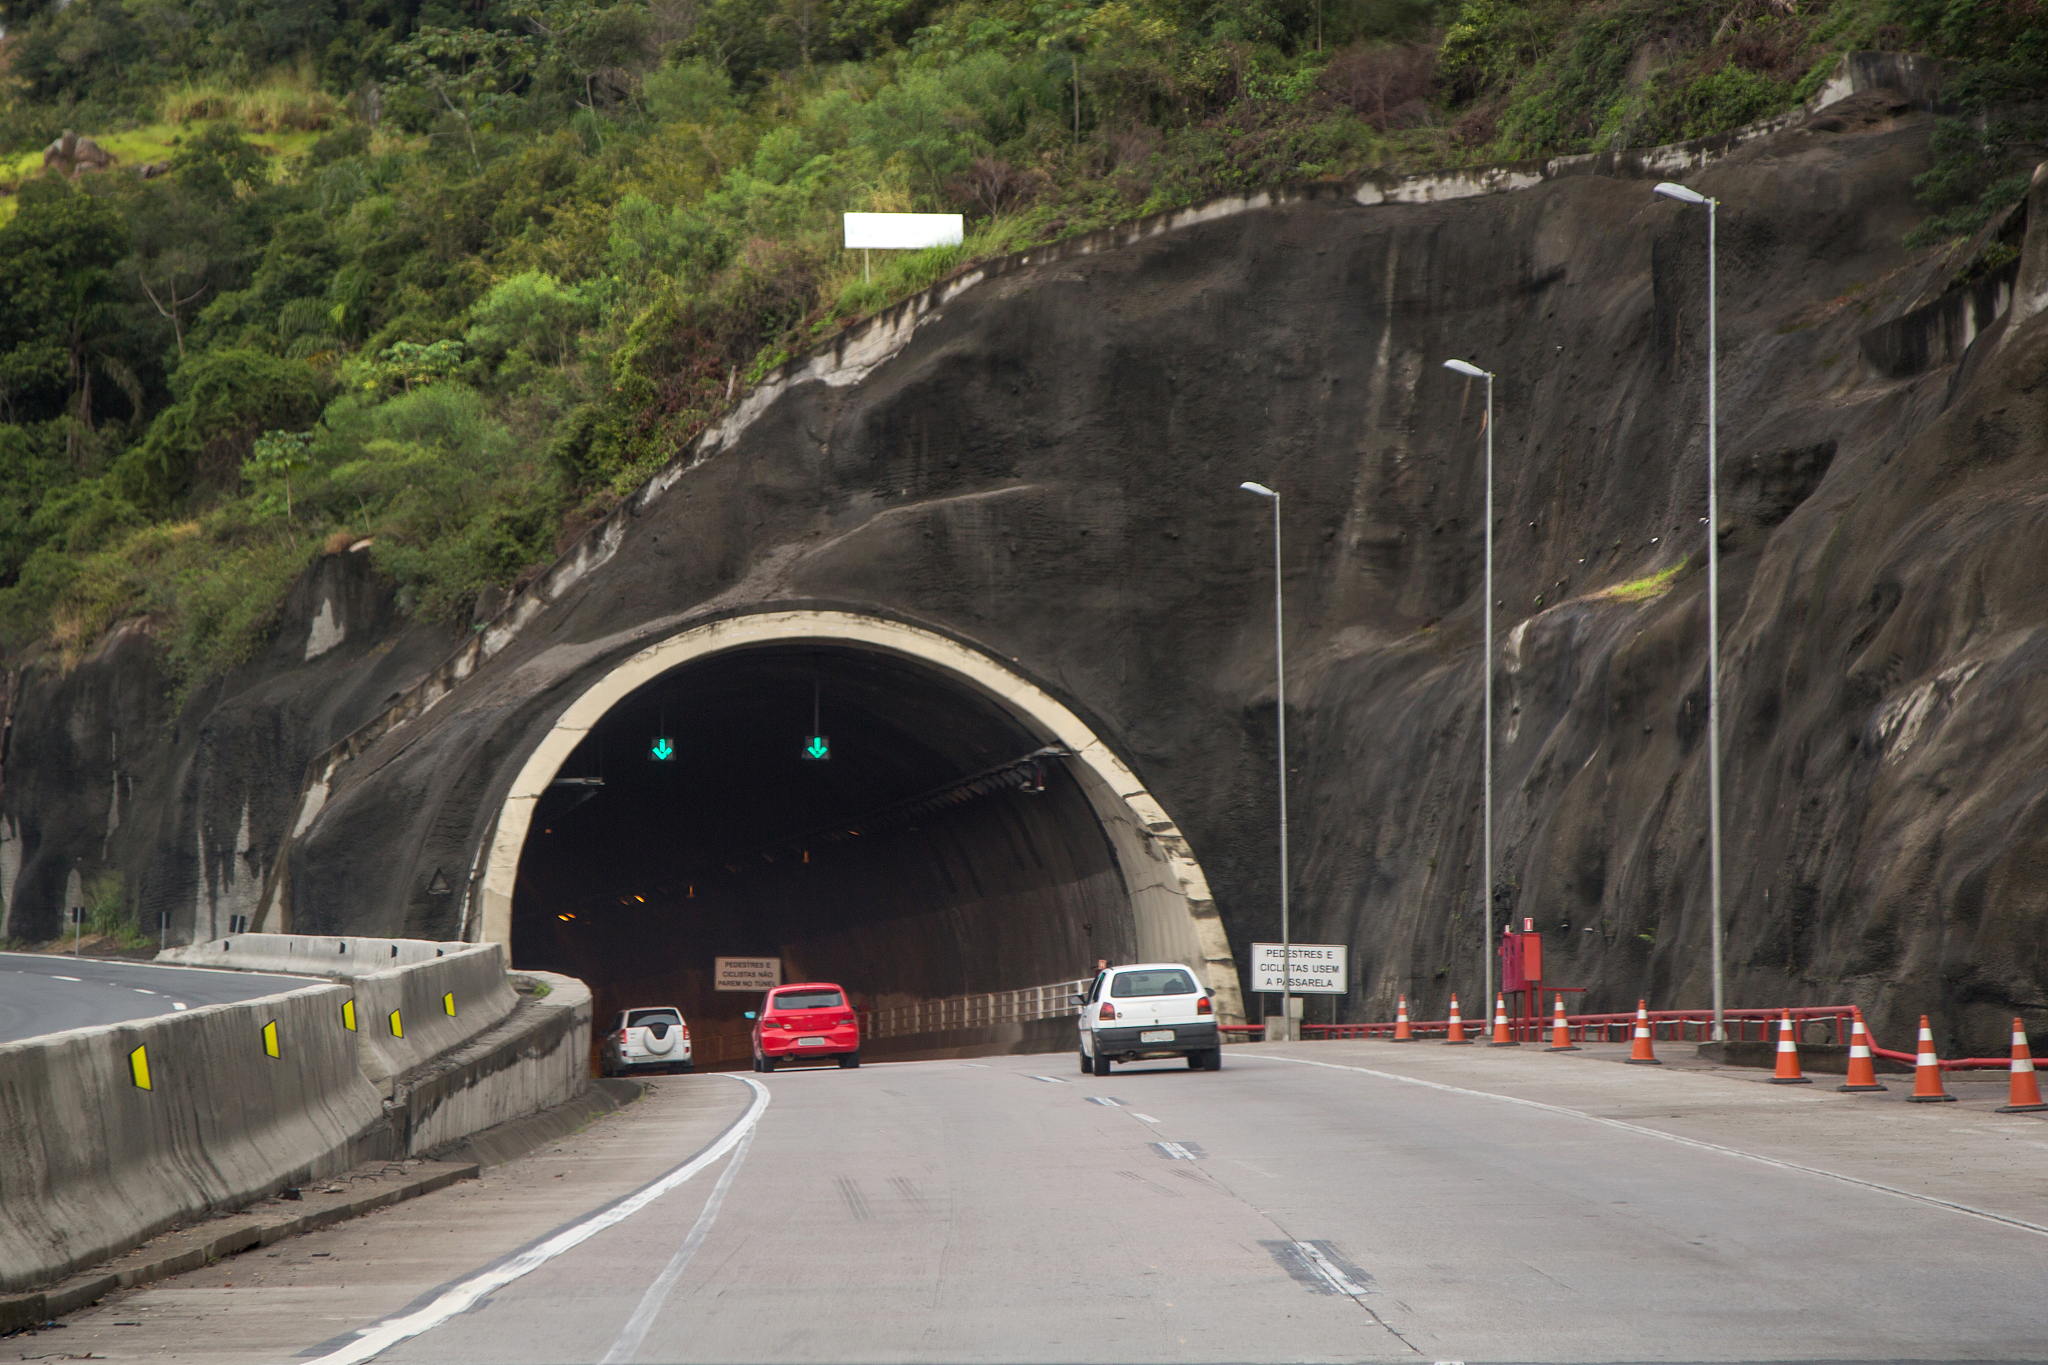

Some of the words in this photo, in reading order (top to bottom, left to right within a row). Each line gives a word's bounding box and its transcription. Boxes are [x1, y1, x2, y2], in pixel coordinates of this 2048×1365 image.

[1266, 950, 1322, 958] PEDESTRES
[1327, 951, 1333, 959] E
[1260, 964, 1308, 972] CICLITAS
[1313, 965, 1339, 973] USEM
[1266, 978, 1273, 986] A
